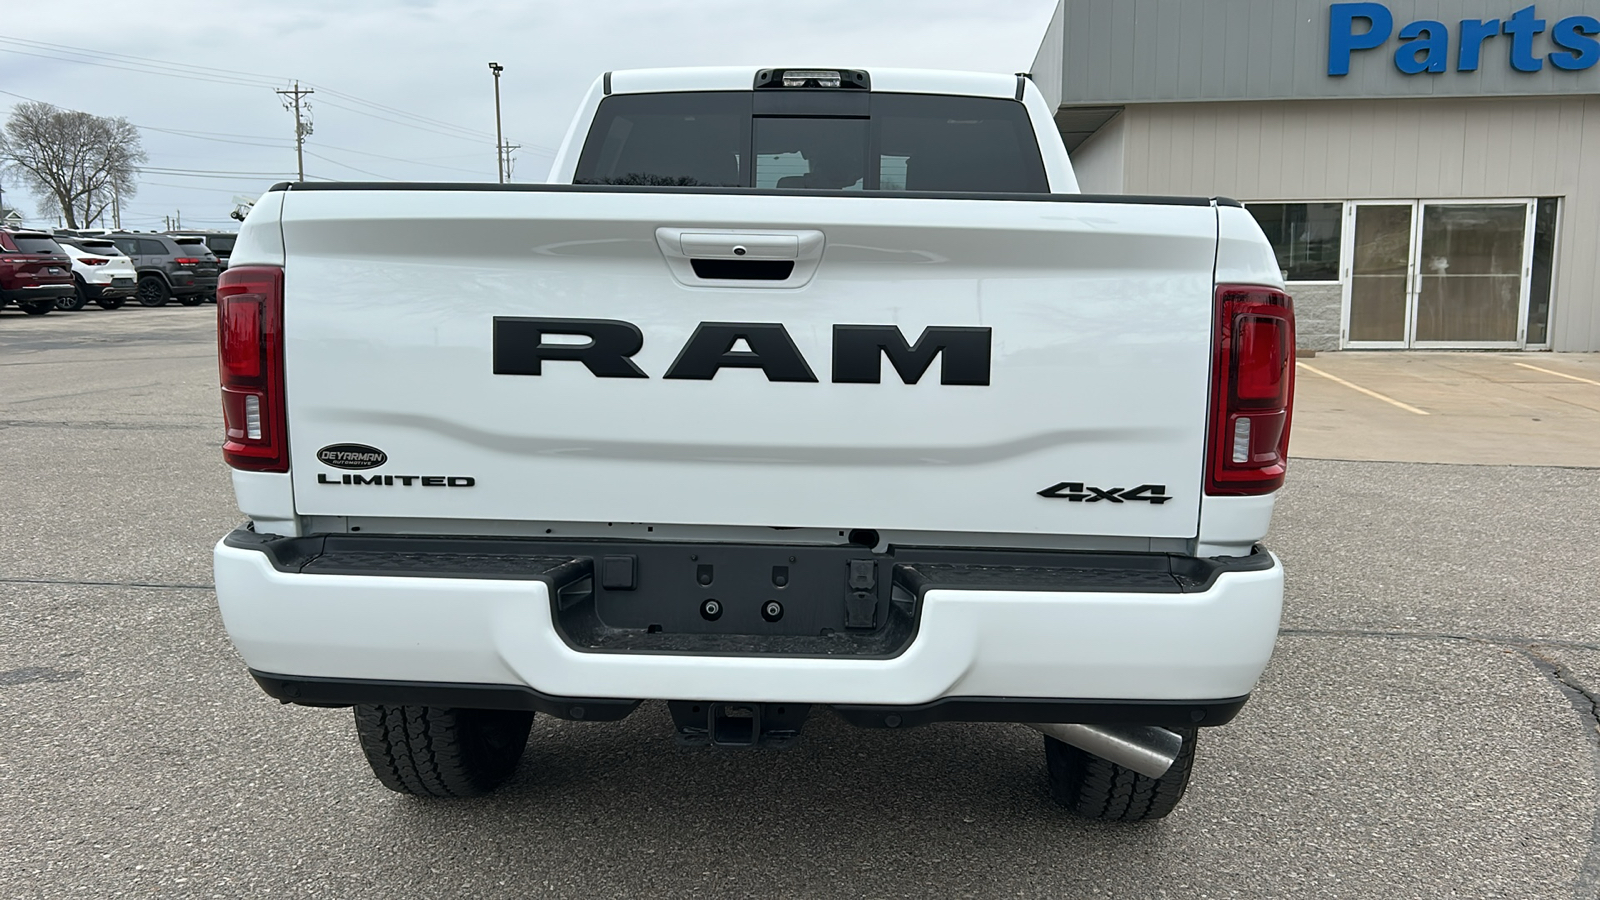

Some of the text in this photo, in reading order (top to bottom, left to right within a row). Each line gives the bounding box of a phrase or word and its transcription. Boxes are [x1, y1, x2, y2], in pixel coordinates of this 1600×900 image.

[1327, 2, 1600, 76] Parts
[493, 316, 992, 385] RAM
[321, 451, 382, 461] DEYARMAN
[317, 473, 476, 487] LIMITED
[1036, 482, 1173, 504] 4x4
